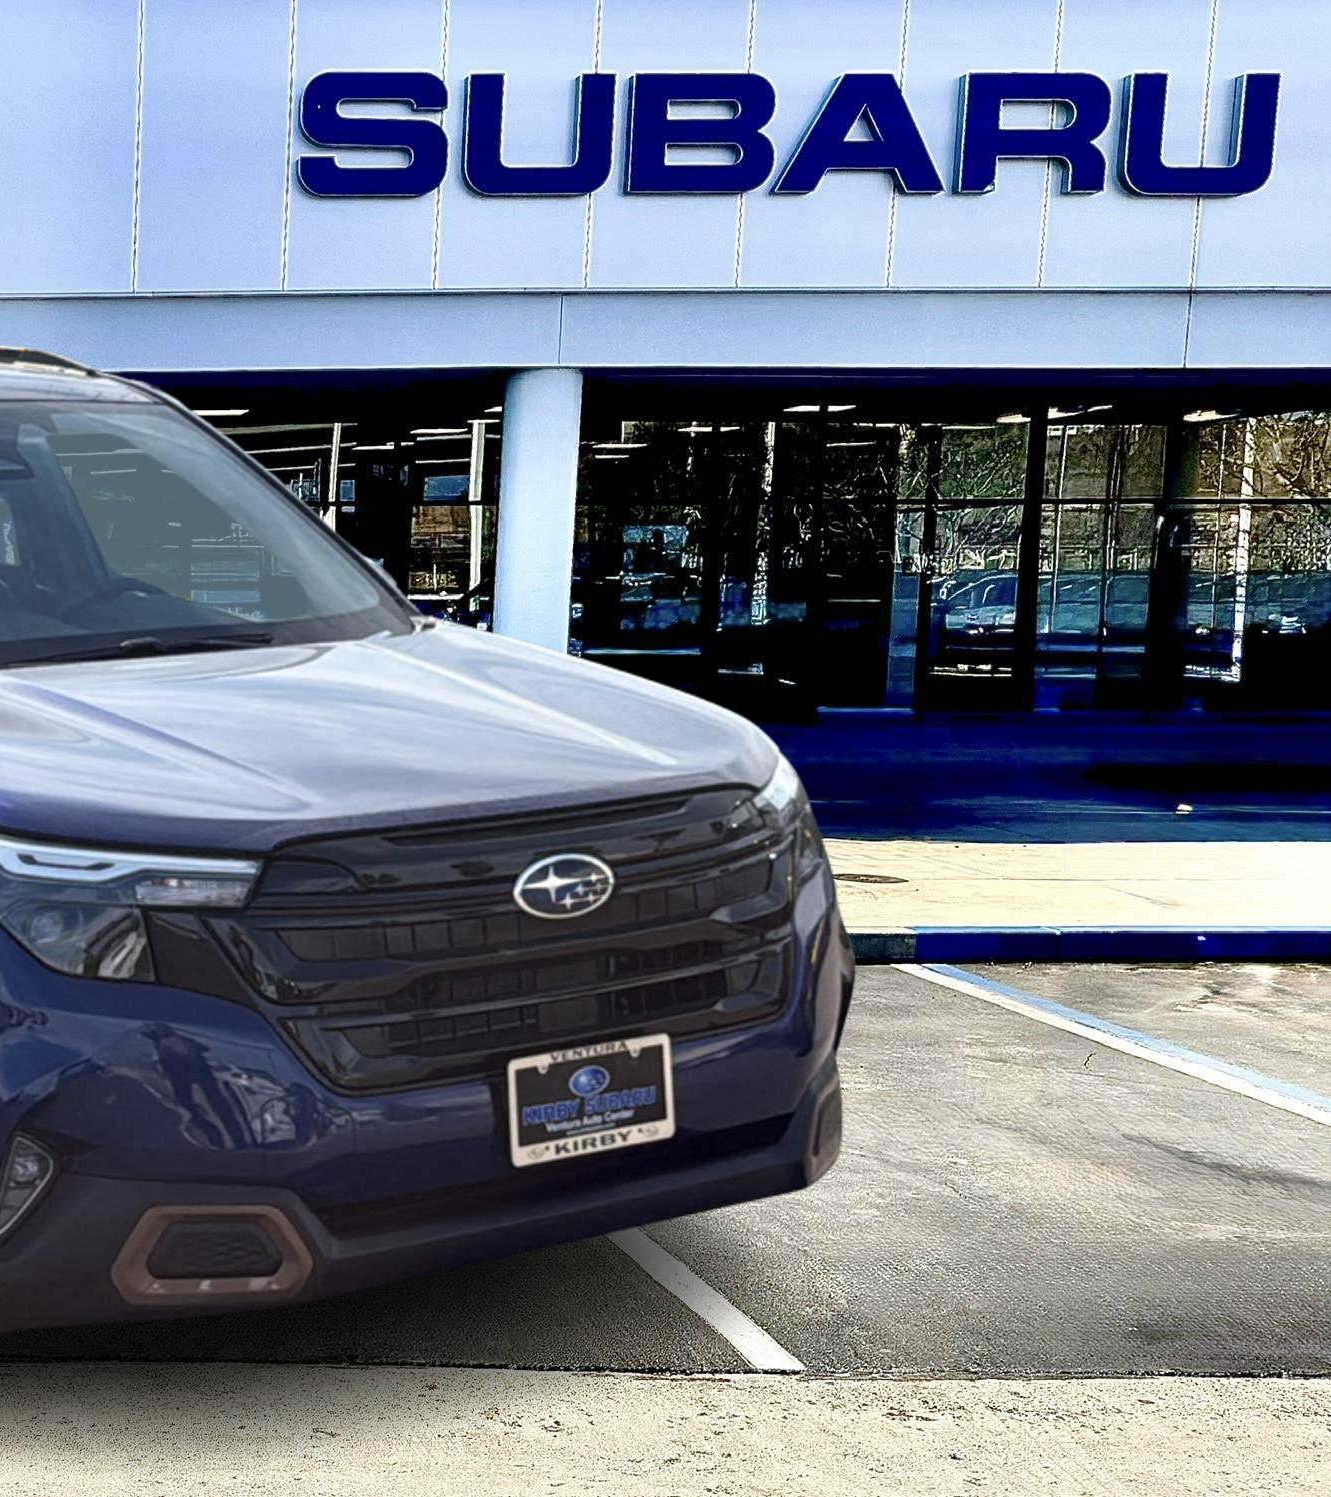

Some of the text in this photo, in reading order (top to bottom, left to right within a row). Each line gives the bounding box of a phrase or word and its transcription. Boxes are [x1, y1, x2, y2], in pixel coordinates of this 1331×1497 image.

[296, 71, 1280, 198] SUBARU
[550, 1041, 628, 1062] VENTURA
[523, 1086, 656, 1125] KIRBY SUBARU
[555, 1130, 632, 1155] KIRBY
